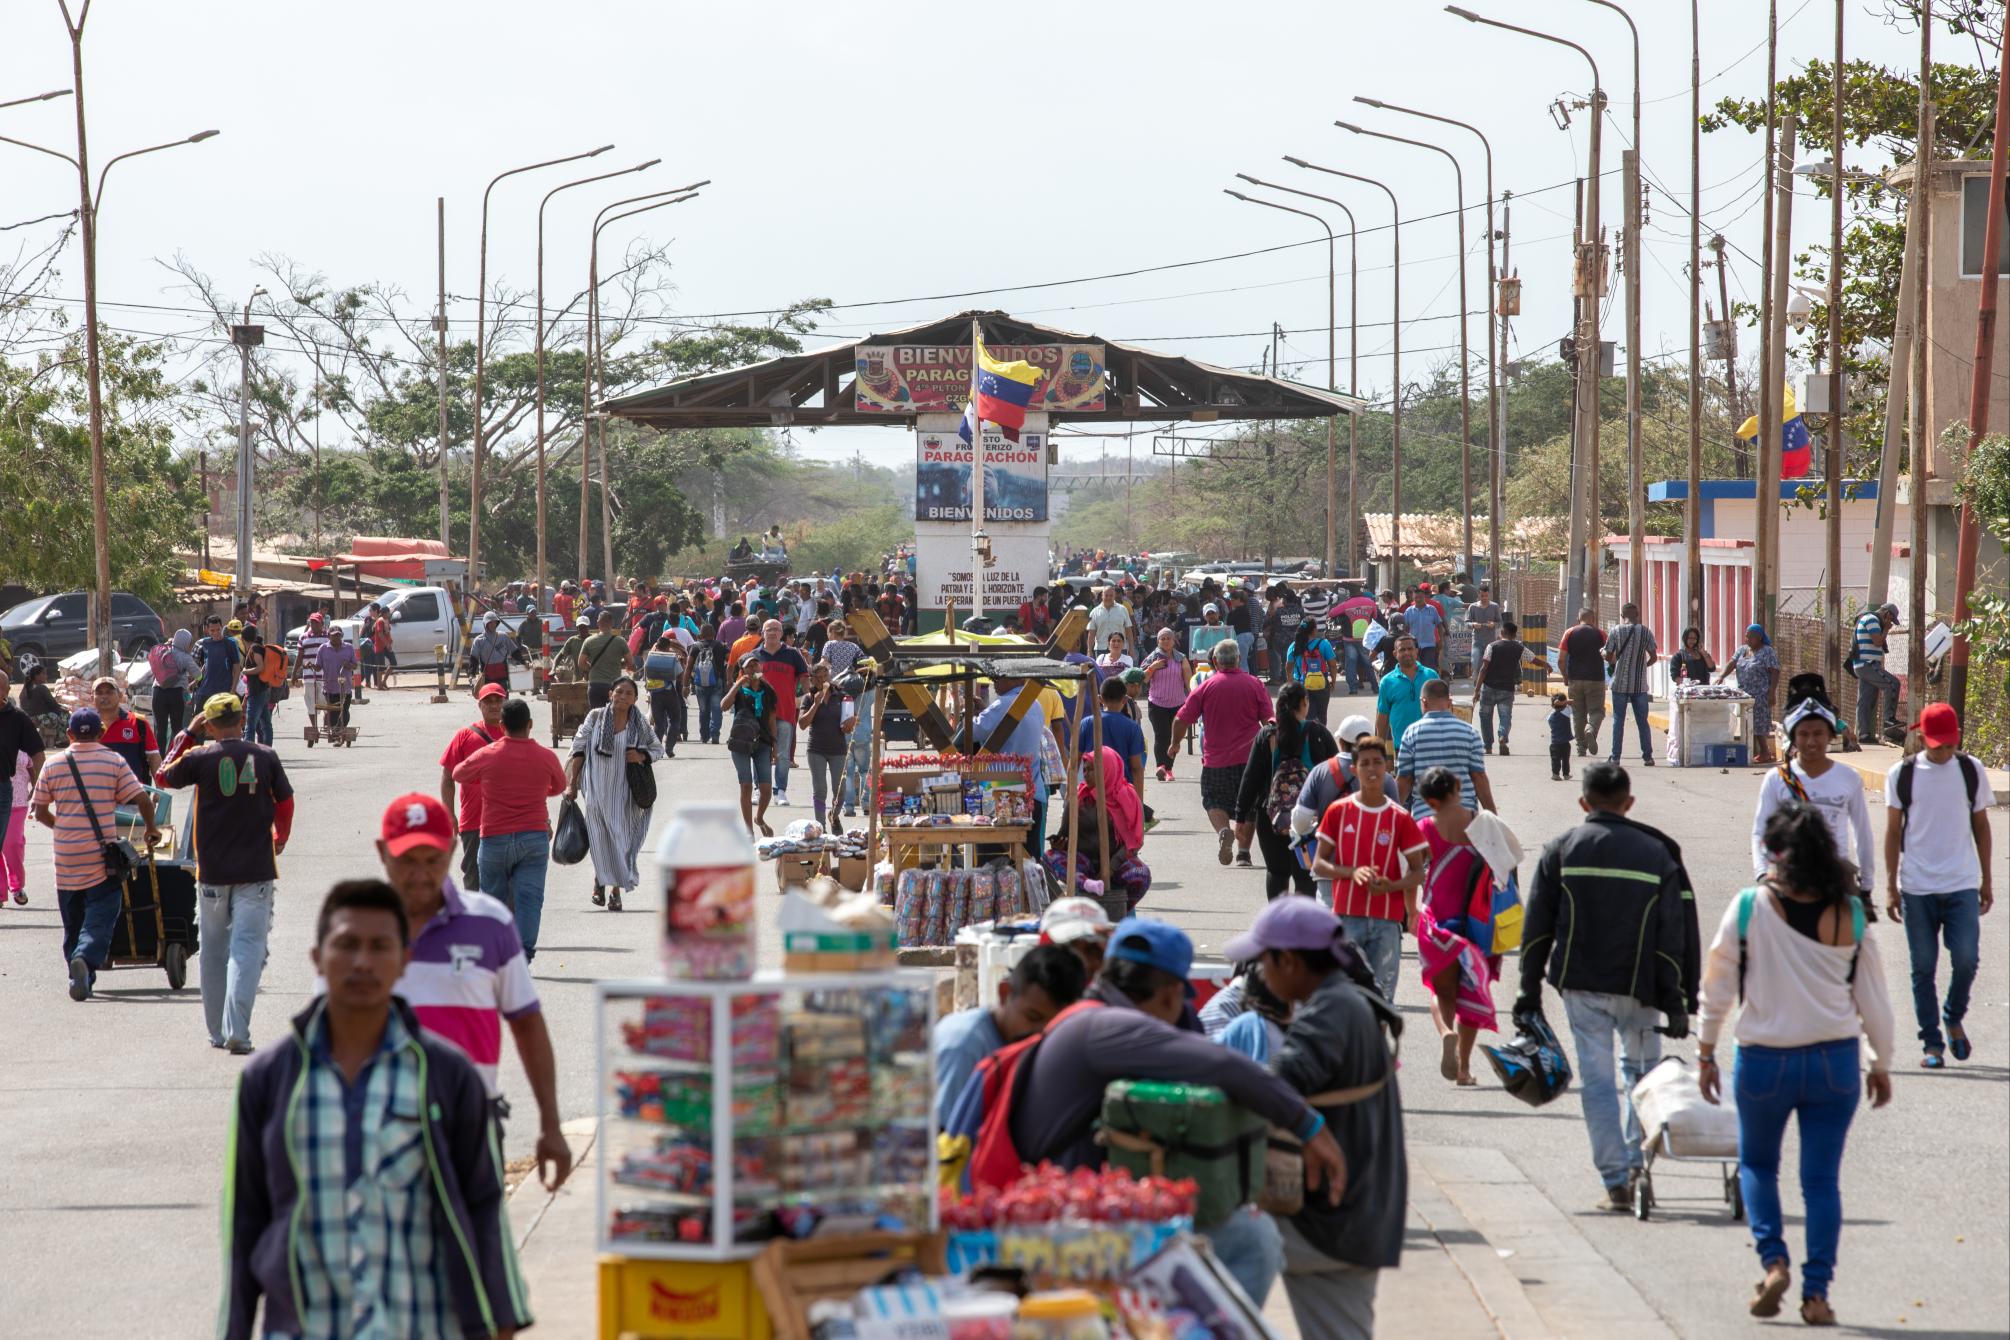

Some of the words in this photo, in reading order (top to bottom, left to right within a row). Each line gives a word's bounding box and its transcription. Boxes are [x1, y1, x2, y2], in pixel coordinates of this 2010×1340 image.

[900, 348, 1058, 364] BIENVNIDOS
[906, 368, 1051, 381] PARAGN
[932, 384, 966, 392] PLTON
[928, 507, 1034, 519] BIENVNIDOS
[986, 572, 1000, 582] LUZ
[1001, 572, 1009, 581] DE
[1010, 572, 1020, 581] LA
[941, 584, 963, 594] PATRIA
[988, 584, 1024, 594] HORIZONTE
[935, 596, 943, 605] LA
[982, 596, 991, 605] DE
[992, 596, 1001, 605] UN
[218, 752, 258, 797] 04
